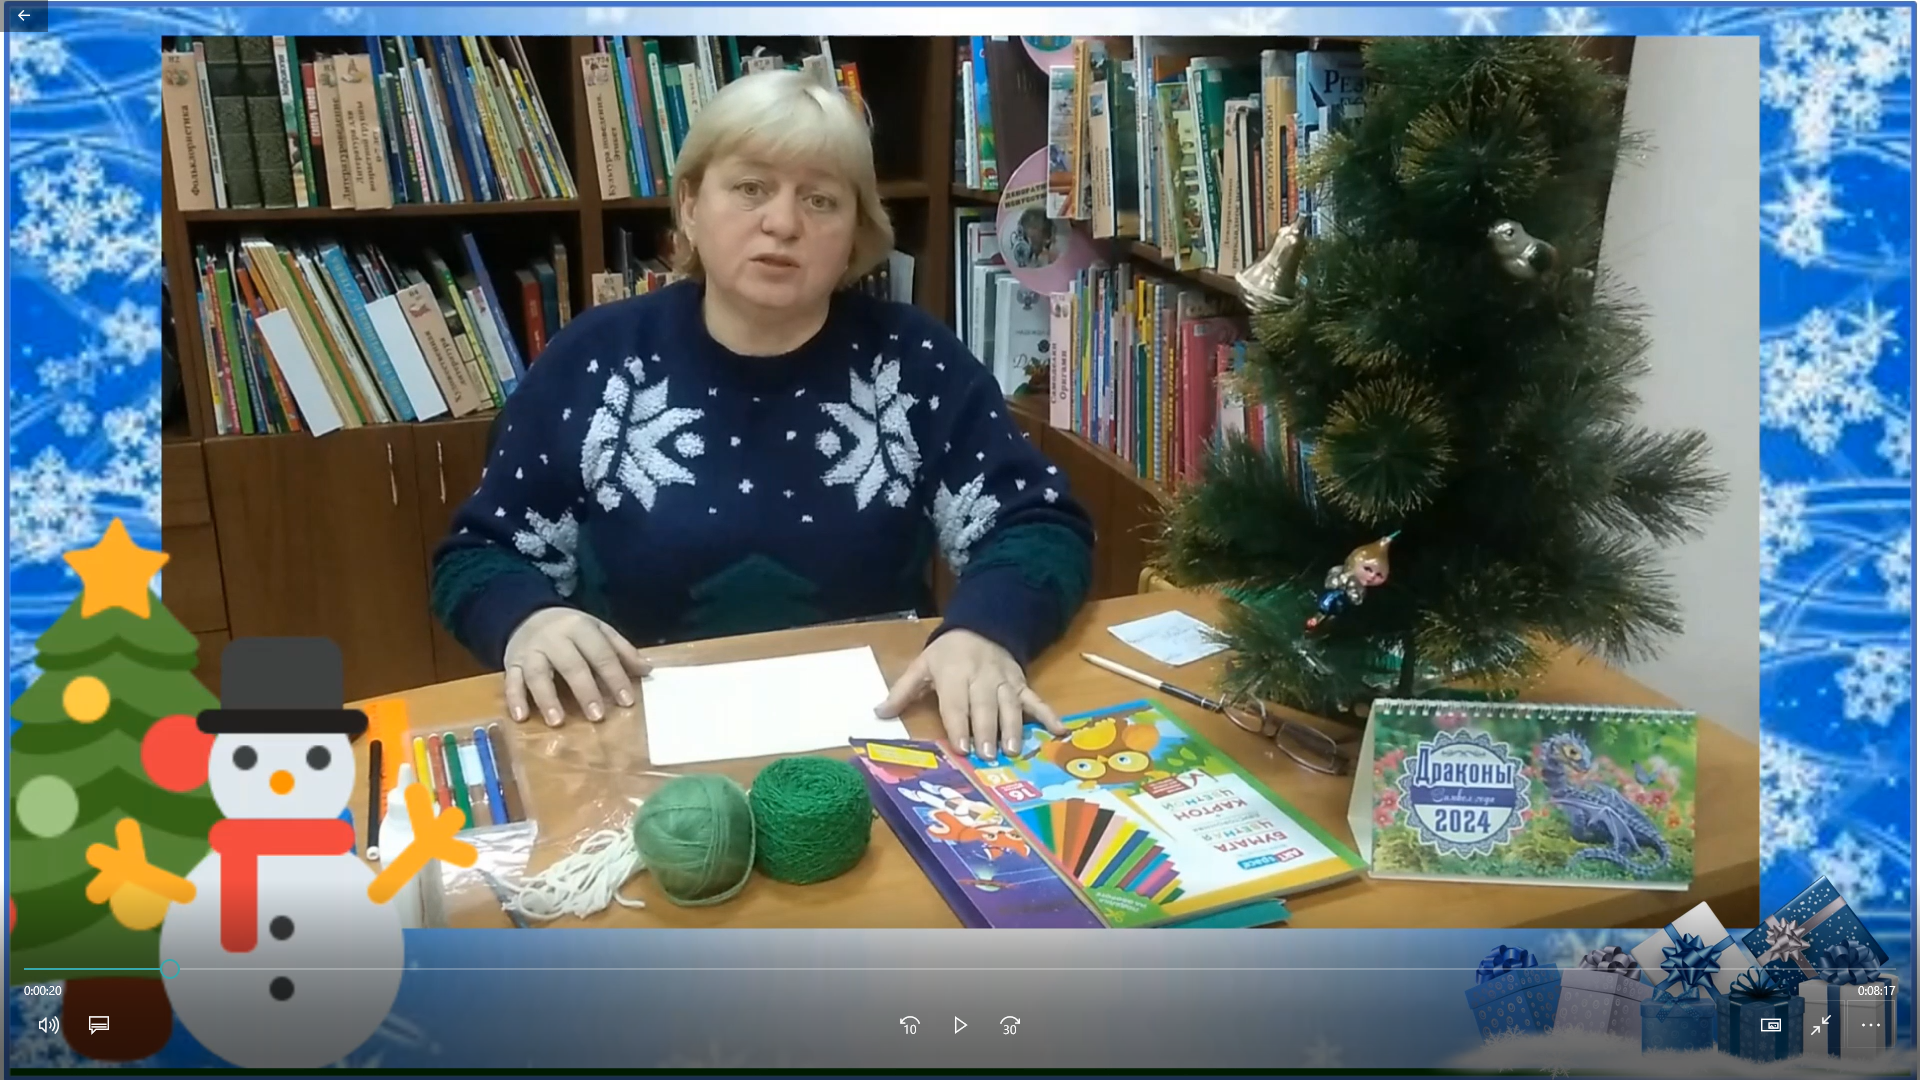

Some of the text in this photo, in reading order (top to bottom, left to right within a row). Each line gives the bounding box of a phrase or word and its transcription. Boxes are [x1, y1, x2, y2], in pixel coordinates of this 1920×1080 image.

[181, 104, 201, 197] Фольклористика
[332, 97, 352, 201] Литературоведение
[347, 109, 364, 184] Литература для
[357, 100, 377, 192] возрастной группы
[596, 92, 617, 197] Культура поведения.
[611, 127, 621, 161] Этикет
[425, 330, 461, 403] Художественная
[440, 337, 467, 387] литература
[1060, 350, 1068, 400] Оригами
[1416, 748, 1511, 786] Драконы
[1009, 788, 1036, 801] 16
[1162, 789, 1235, 811] ЦВЕТНОЙ
[1173, 798, 1248, 821] КАРТОН
[1202, 820, 1274, 841] ЦВЕТНАЯ
[1214, 831, 1287, 853] БУМАГА
[1435, 809, 1491, 833] 2024
